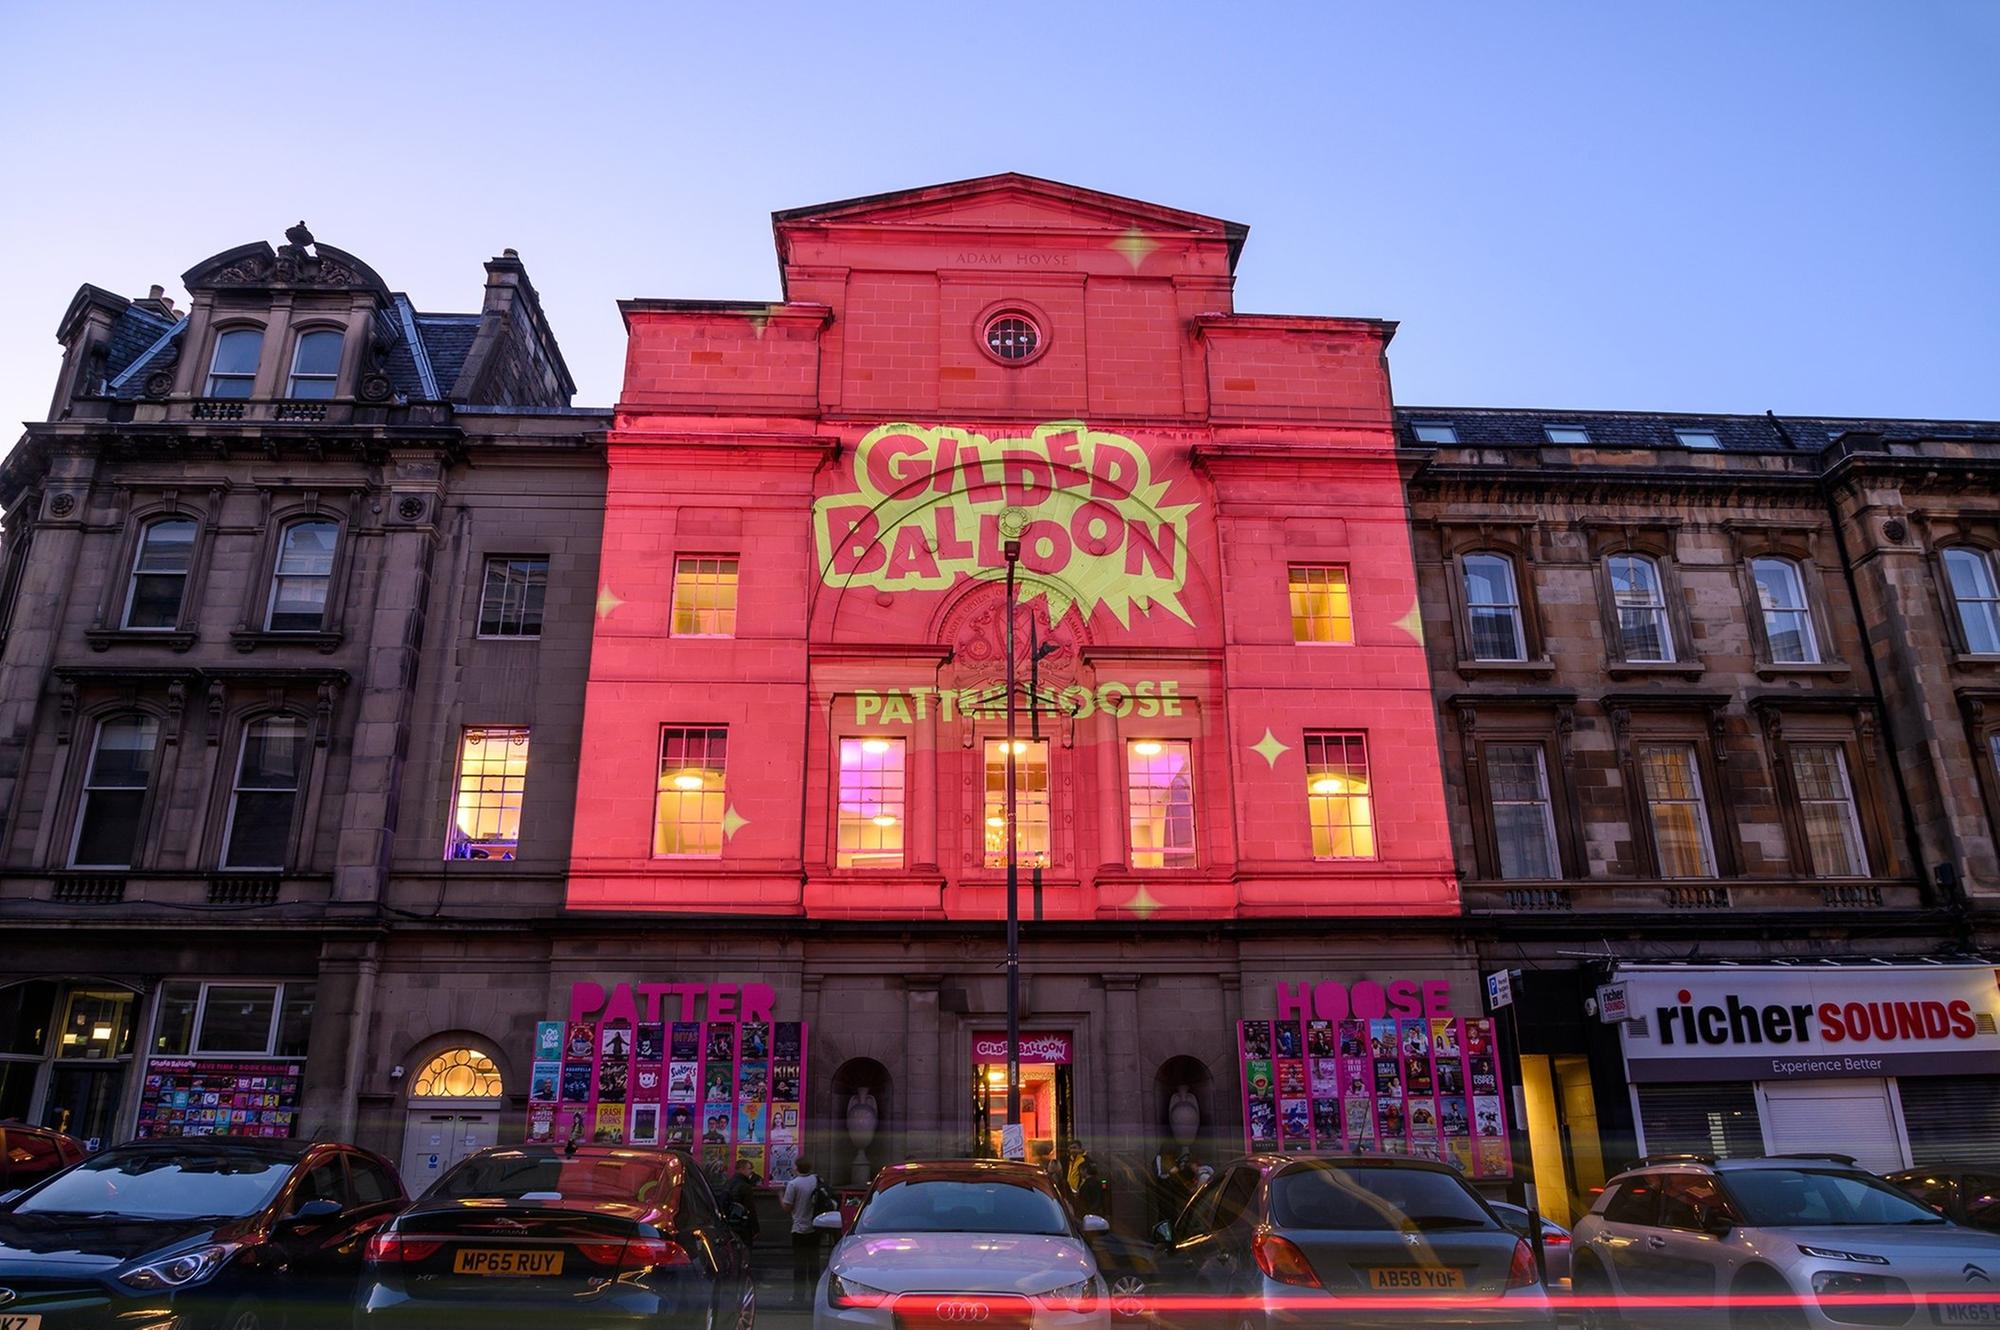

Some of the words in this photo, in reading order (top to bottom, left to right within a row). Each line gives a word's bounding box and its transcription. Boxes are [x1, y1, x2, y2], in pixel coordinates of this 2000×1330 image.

[955, 253, 1002, 265] ADAM
[1015, 253, 1070, 266] HOVSE
[865, 430, 1139, 507] GILDED
[825, 500, 1176, 581] BALLOON
[855, 684, 1009, 726] PATTER
[1024, 680, 1182, 720] HOOSE
[570, 983, 776, 1023] PATTER
[1276, 980, 1455, 1019] HOOSE
[1603, 988, 1624, 1002] richer
[1604, 1000, 1626, 1012] SOUNDS
[1657, 989, 1814, 1045] richer
[1817, 1000, 1976, 1043] SOUNDS
[977, 1041, 1009, 1055] GILDE
[1772, 1059, 1842, 1075] Experience
[1844, 1058, 1882, 1071] Better
[461, 1252, 513, 1271] MP65
[516, 1254, 556, 1272] RUY
[1378, 1270, 1422, 1287] AB58
